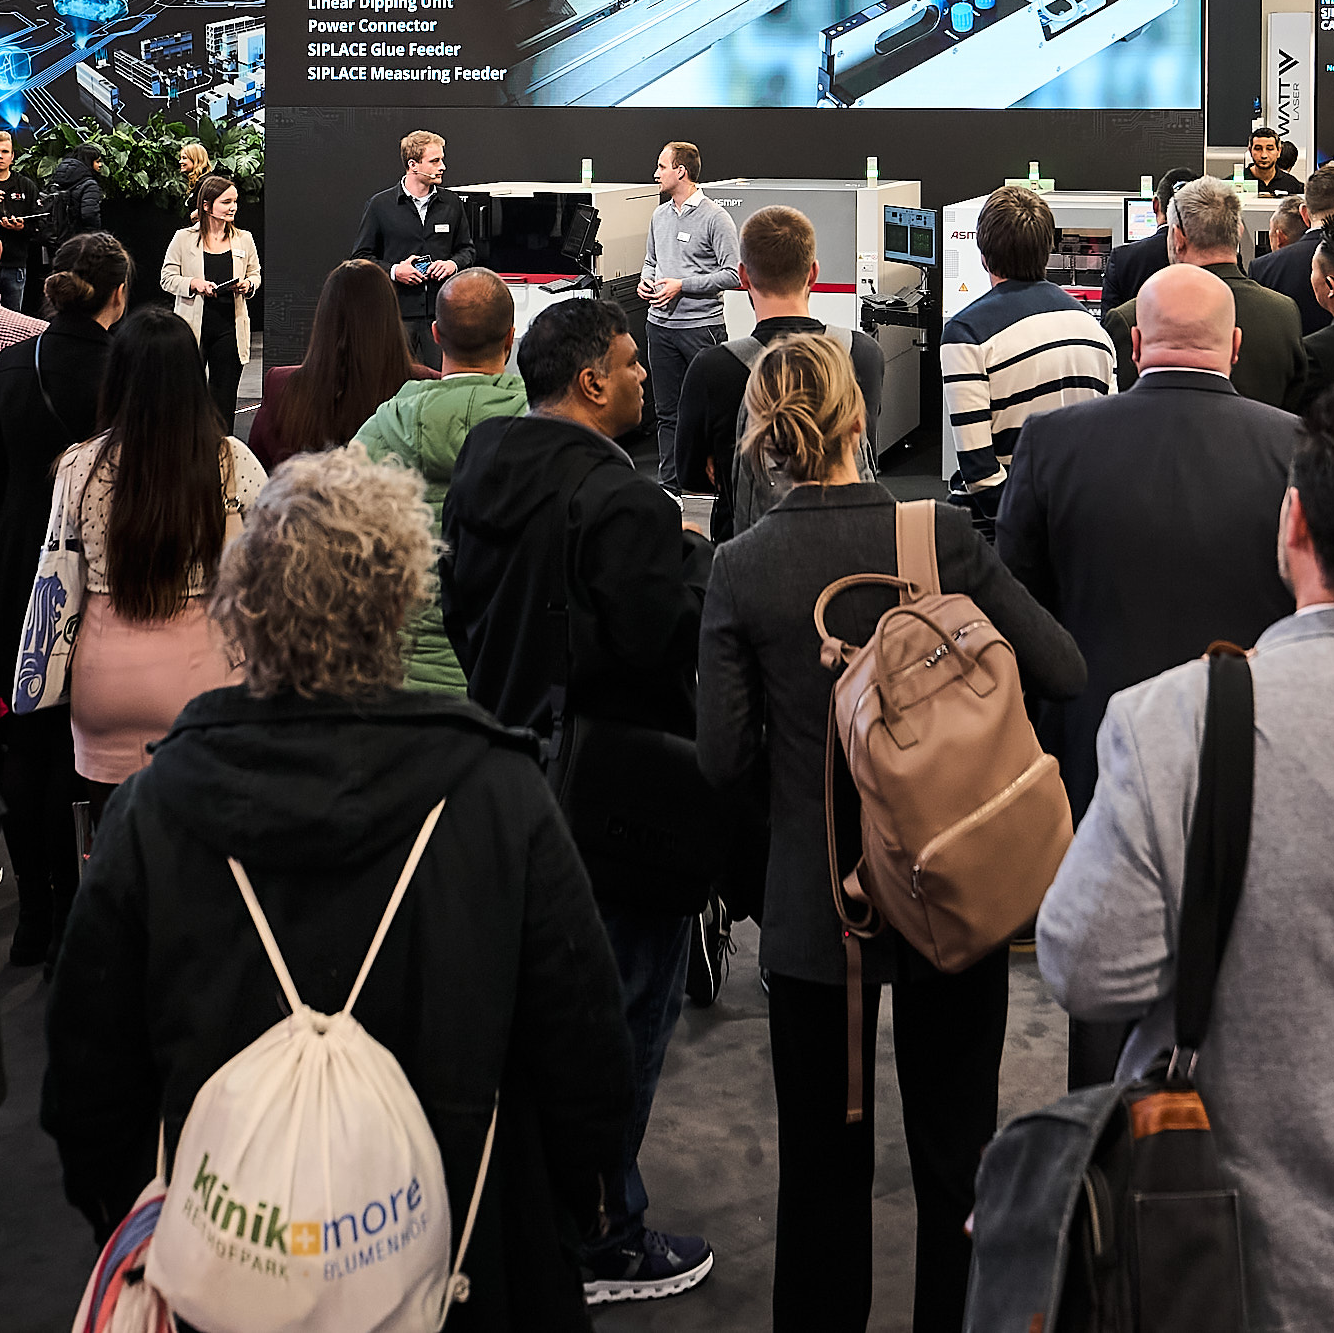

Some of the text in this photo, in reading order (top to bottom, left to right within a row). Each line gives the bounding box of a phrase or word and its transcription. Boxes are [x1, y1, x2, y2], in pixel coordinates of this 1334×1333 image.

[308, 18, 438, 33] Power Connector
[307, 41, 462, 57] SIPLACE Glue Feeder
[307, 65, 508, 84] SIPLACE Measuring Feeder
[323, 1176, 423, 1254] more
